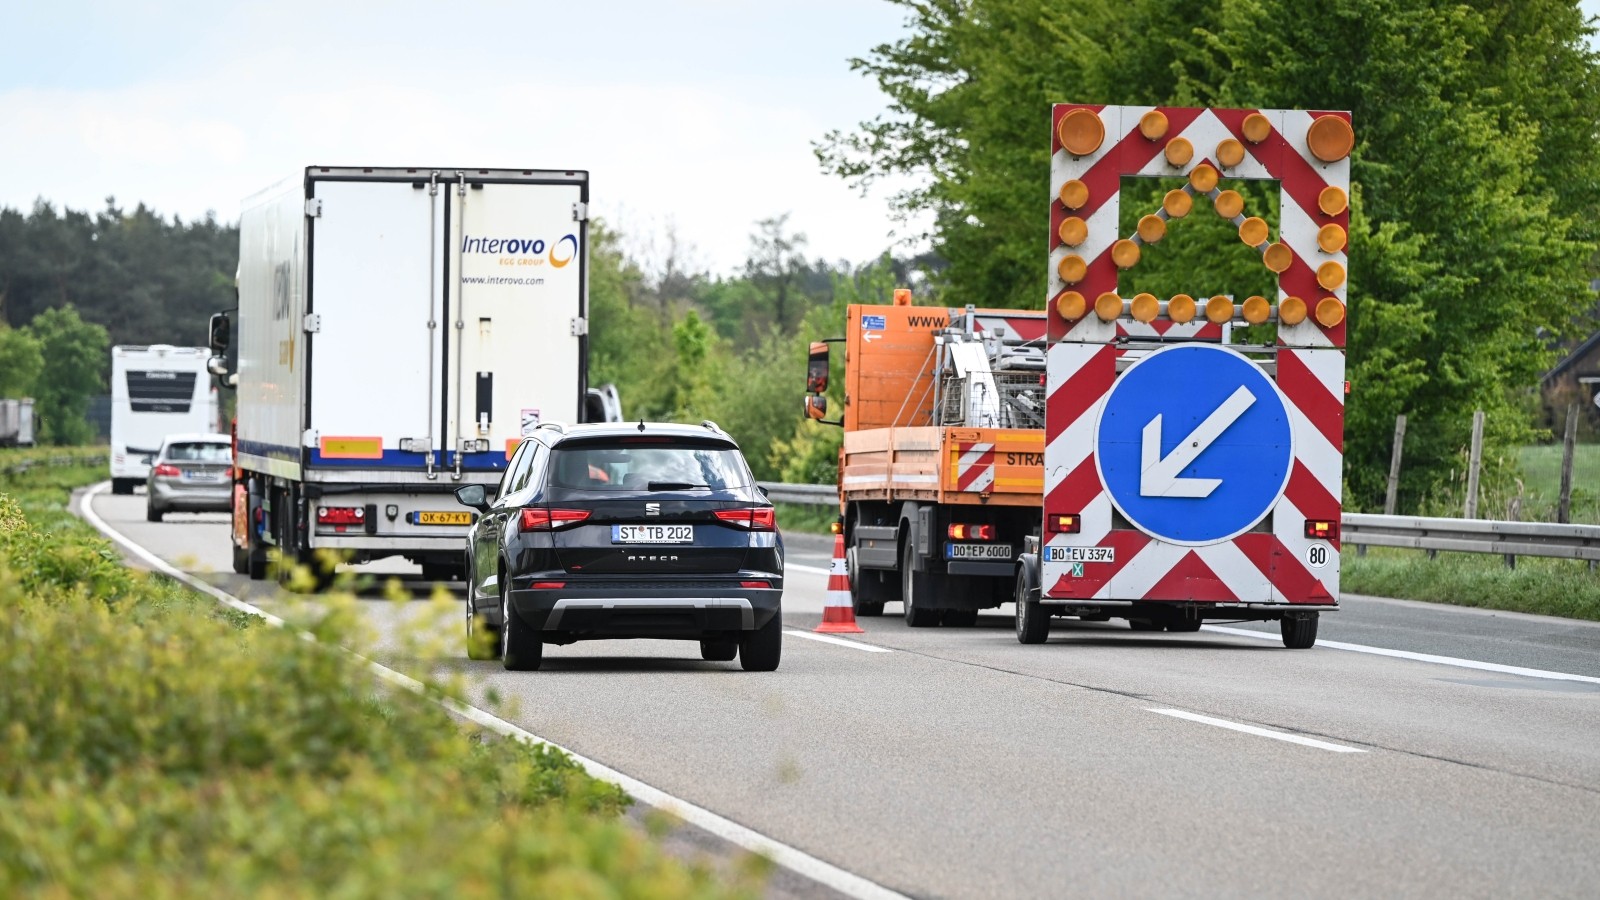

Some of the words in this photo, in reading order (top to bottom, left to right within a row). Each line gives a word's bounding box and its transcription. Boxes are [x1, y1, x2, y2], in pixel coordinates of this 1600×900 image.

[462, 235, 545, 255] Interovo
[499, 258, 515, 266] EGG
[517, 258, 545, 267] GROUP
[462, 275, 545, 285] www.interovo.com
[620, 527, 638, 540] ST
[646, 527, 664, 540] TB
[667, 527, 692, 540] 202
[953, 545, 966, 556] DO
[972, 545, 985, 557] EP
[986, 546, 1010, 557] 6000
[1051, 548, 1065, 560] BO
[1072, 548, 1086, 560] EV
[1087, 549, 1113, 560] 3374
[1309, 547, 1326, 564] 80
